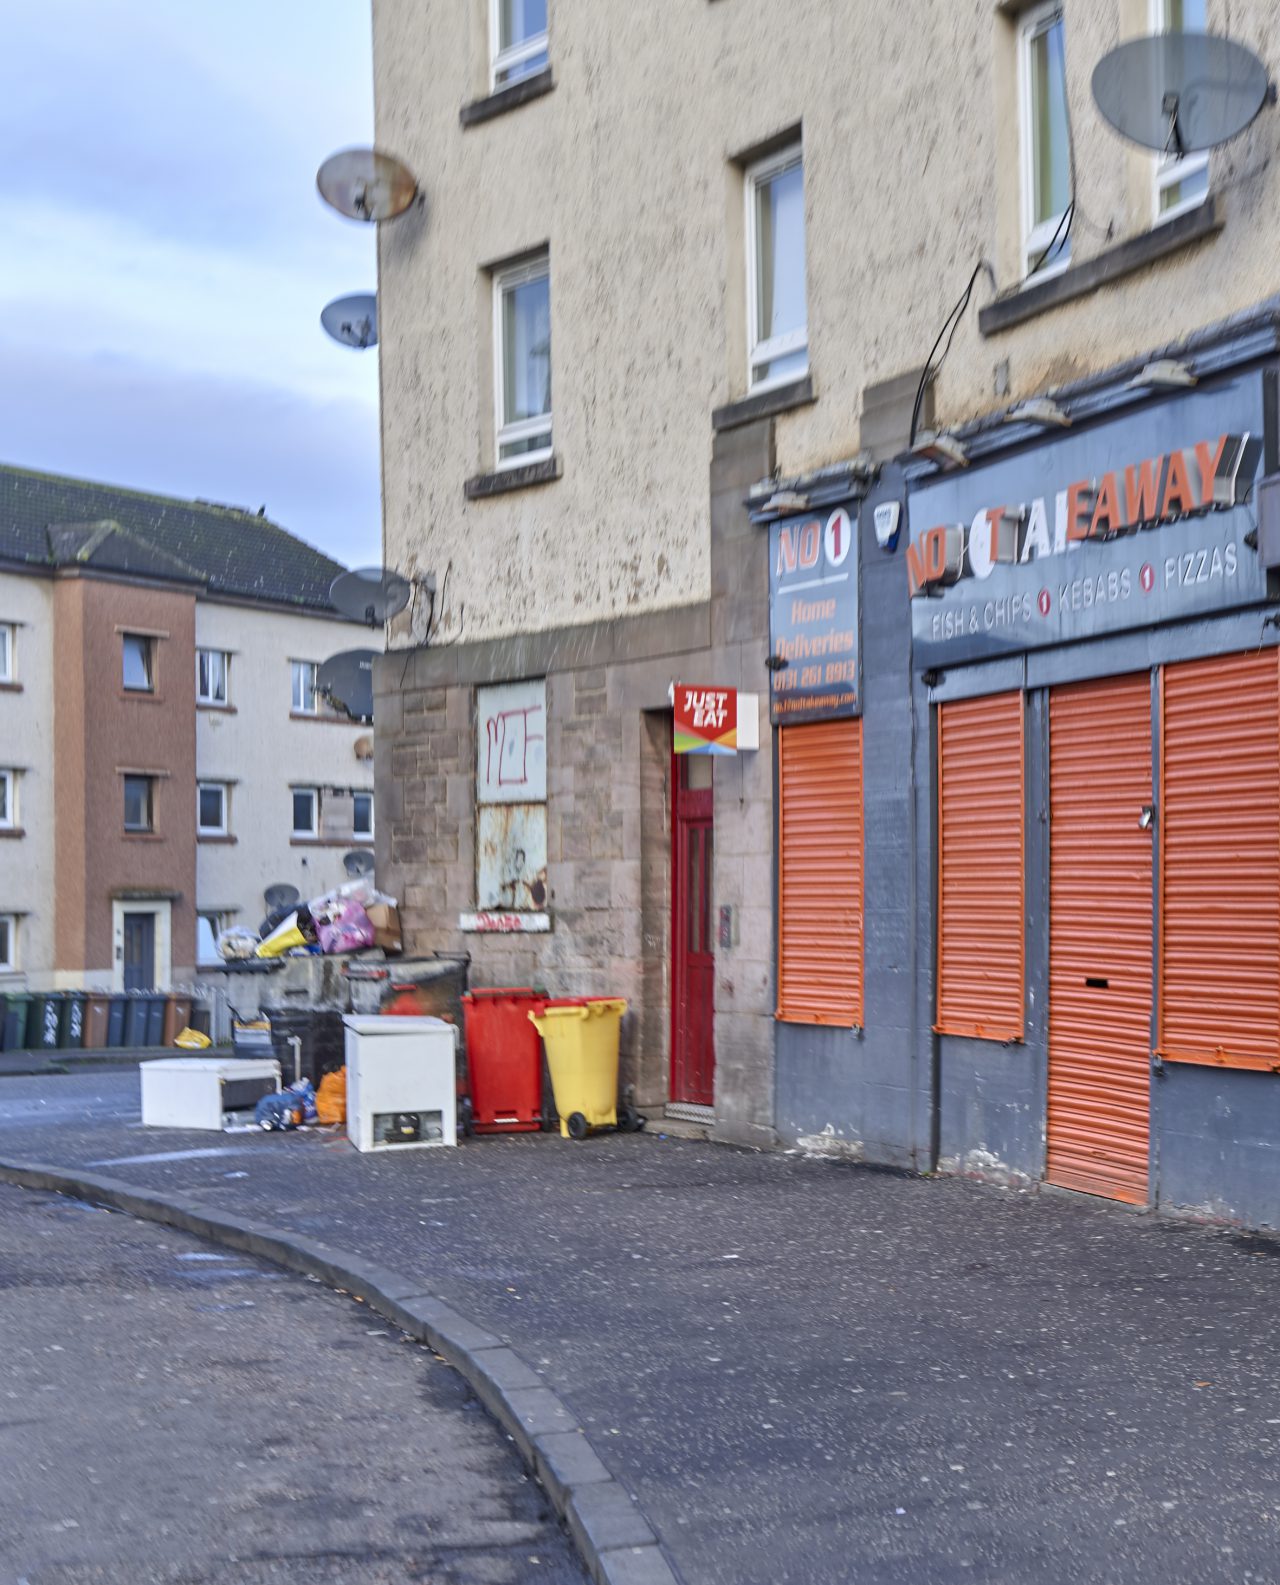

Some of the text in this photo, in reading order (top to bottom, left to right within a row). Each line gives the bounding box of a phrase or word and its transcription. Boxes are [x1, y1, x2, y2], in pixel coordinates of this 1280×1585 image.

[776, 519, 822, 577] NO
[906, 526, 948, 598] NO
[932, 607, 964, 641] FISH
[969, 604, 980, 635] &
[983, 591, 1032, 631] CHIPS
[1058, 567, 1132, 614] KEBABS
[1164, 542, 1238, 590] PIZZAS
[792, 598, 836, 625] Home
[776, 629, 854, 661] Deliveries
[773, 668, 797, 693] 0131
[683, 690, 728, 713] JUST
[693, 708, 728, 729] EAT
